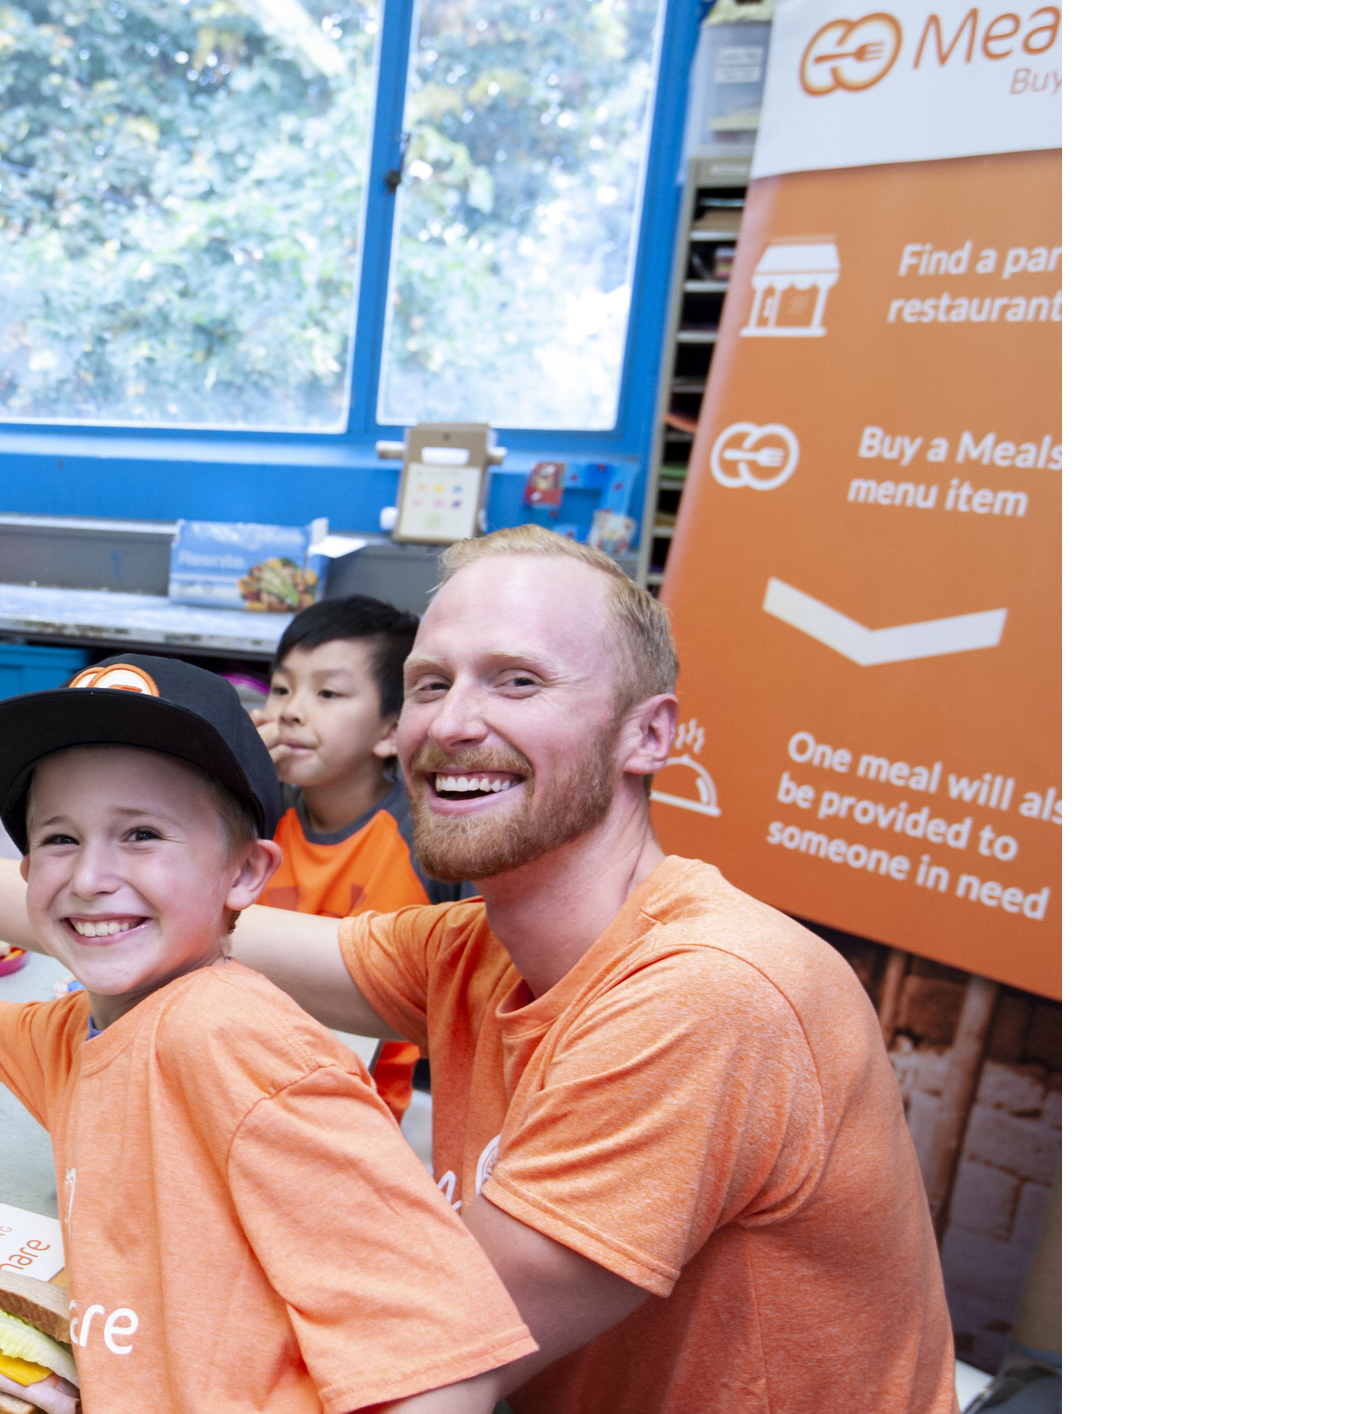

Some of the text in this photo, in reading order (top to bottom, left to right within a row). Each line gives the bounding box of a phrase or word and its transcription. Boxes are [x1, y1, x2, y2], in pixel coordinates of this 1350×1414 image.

[898, 239, 1062, 280] Find a par
[858, 425, 923, 467] Buy
[926, 436, 949, 462] a
[847, 477, 1029, 518] menu item
[788, 731, 852, 773] One
[856, 754, 943, 794] meal
[948, 773, 1015, 811] will
[777, 771, 1018, 861] be provided to
[766, 820, 1050, 921] someone in need
